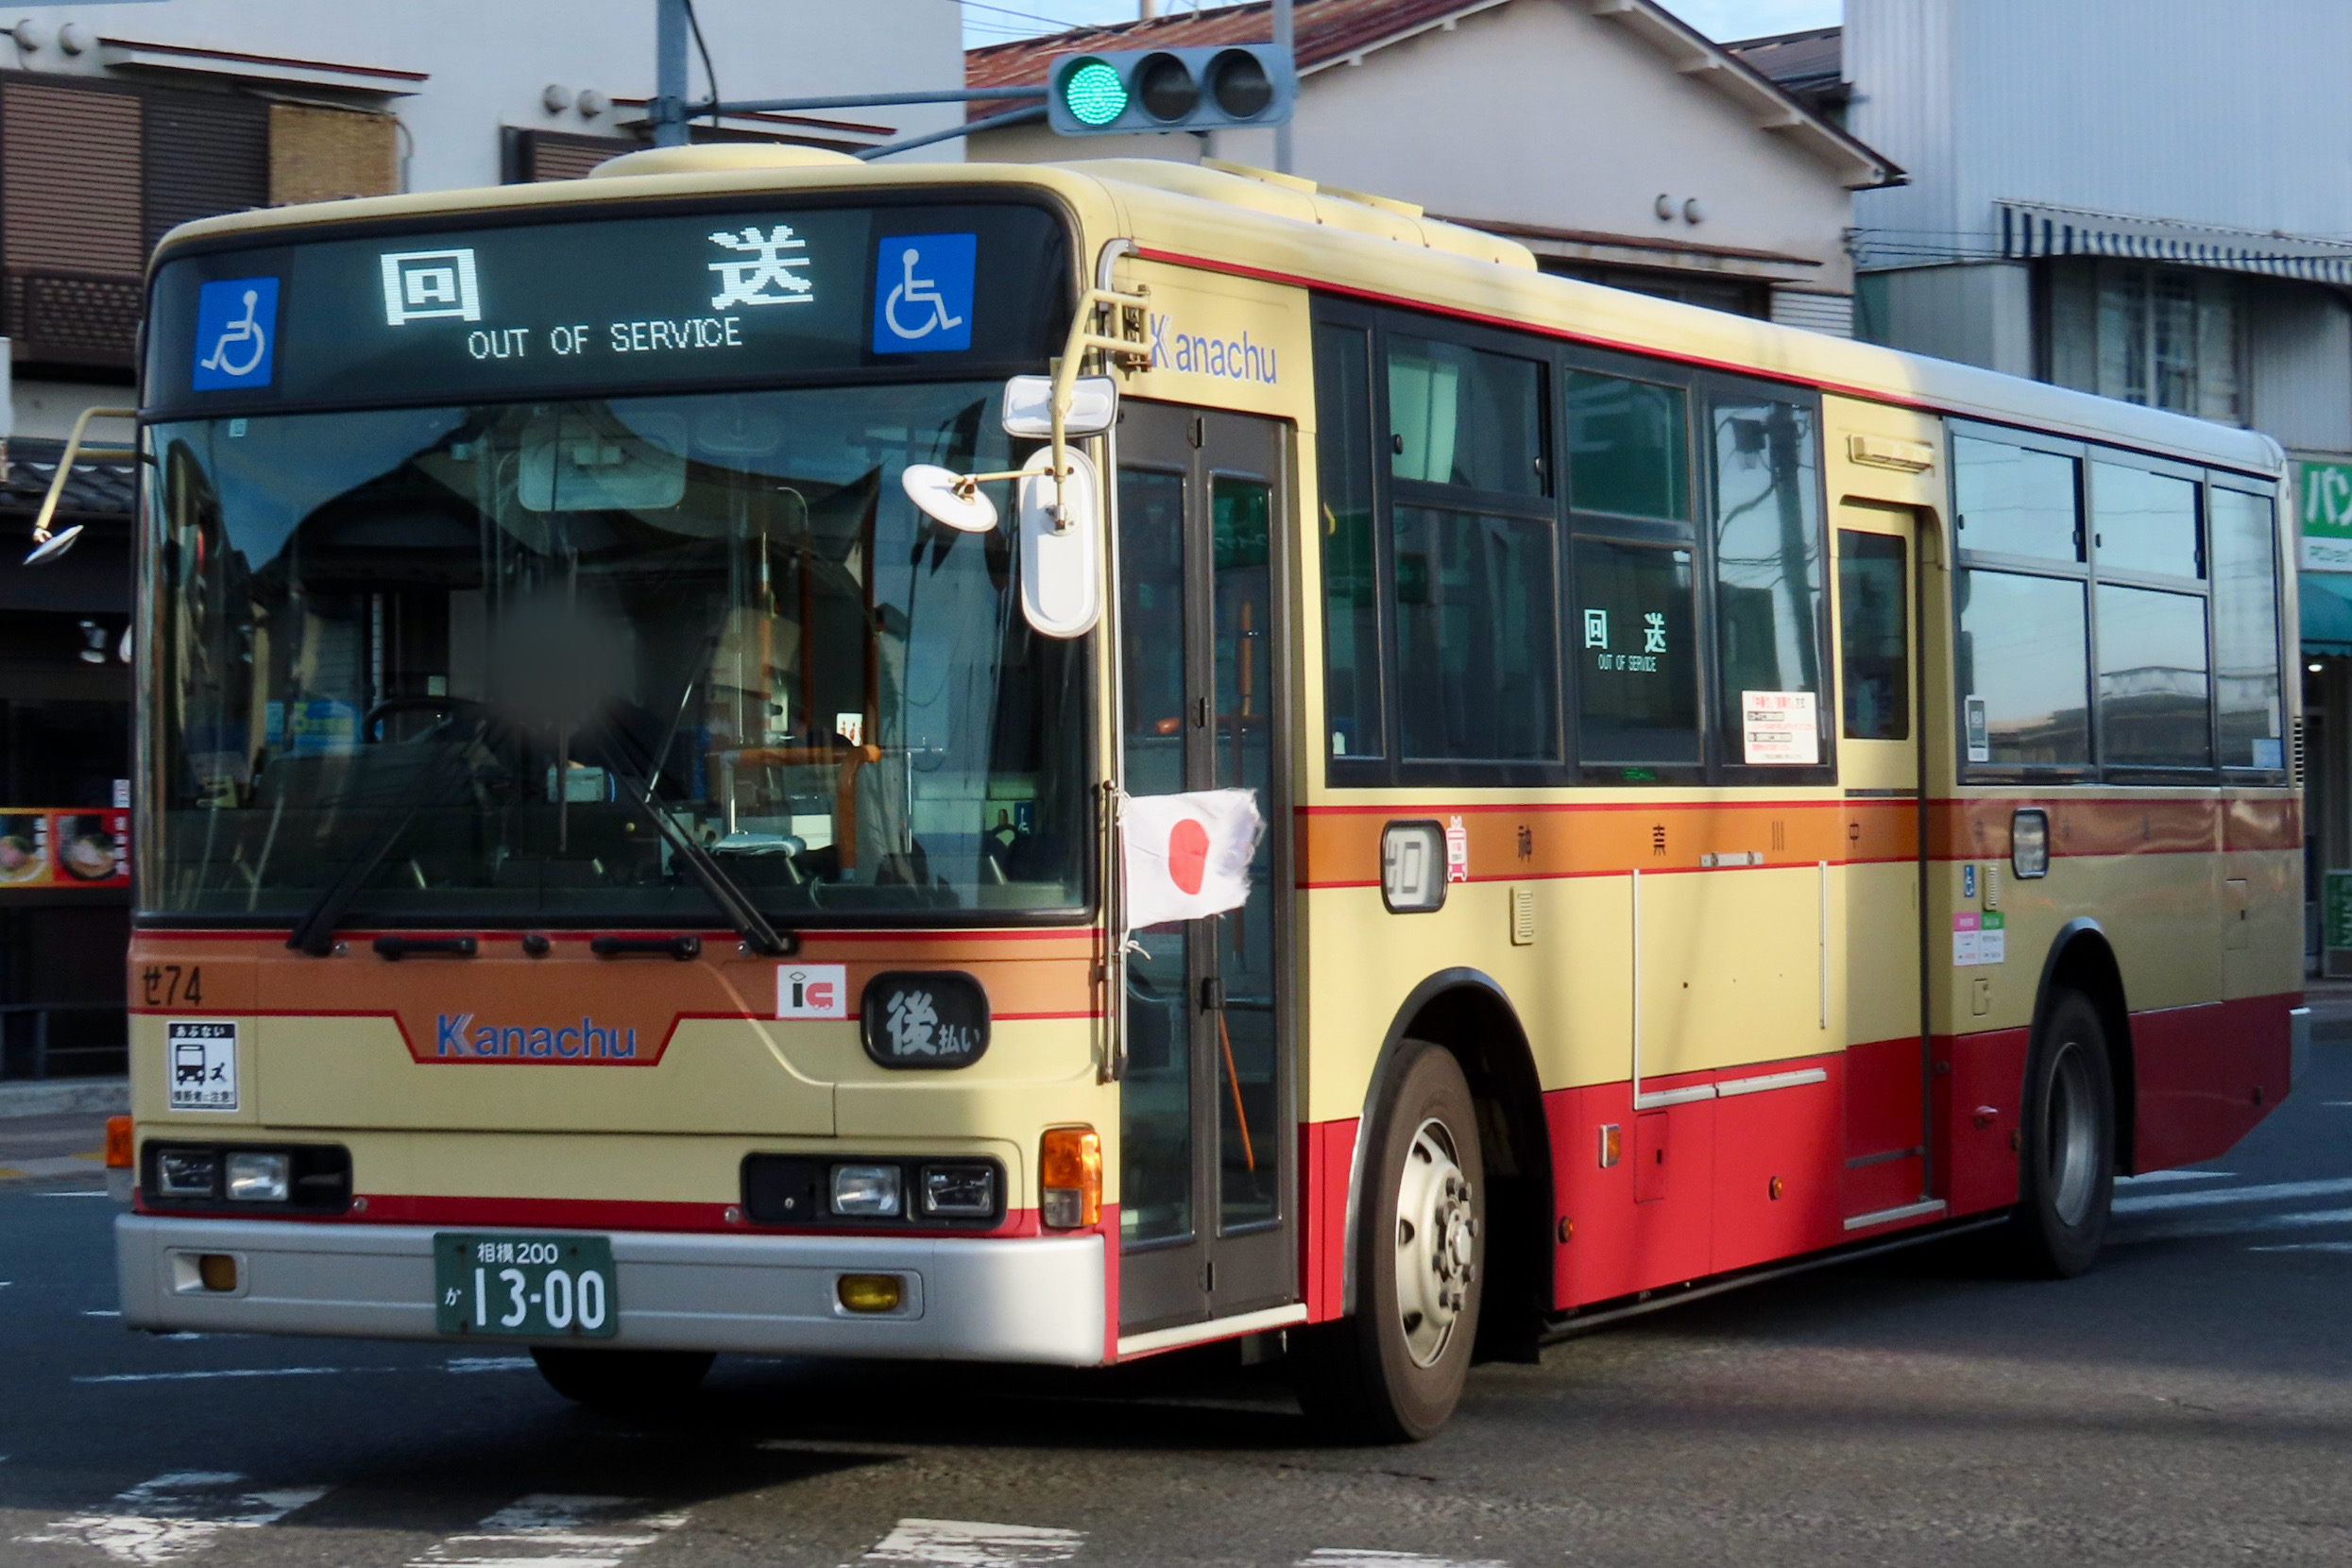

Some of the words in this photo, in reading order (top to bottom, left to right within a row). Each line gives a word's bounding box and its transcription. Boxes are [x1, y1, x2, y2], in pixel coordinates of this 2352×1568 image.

[380, 224, 814, 326] 回送
[468, 328, 530, 361] OUT
[550, 325, 590, 355] OF
[610, 315, 742, 352] SERVICE
[1150, 313, 1278, 385] Kanachu
[1584, 608, 1666, 654] 回送
[1597, 653, 1613, 671] OUT
[1615, 654, 1627, 671] OF
[1628, 655, 1658, 673] SERVICE
[141, 964, 204, 1008] せ74
[436, 1013, 637, 1058] Kanachu
[886, 989, 981, 1056] 後払い
[477, 1242, 559, 1265] 相模200
[474, 1268, 606, 1330] 13-00
